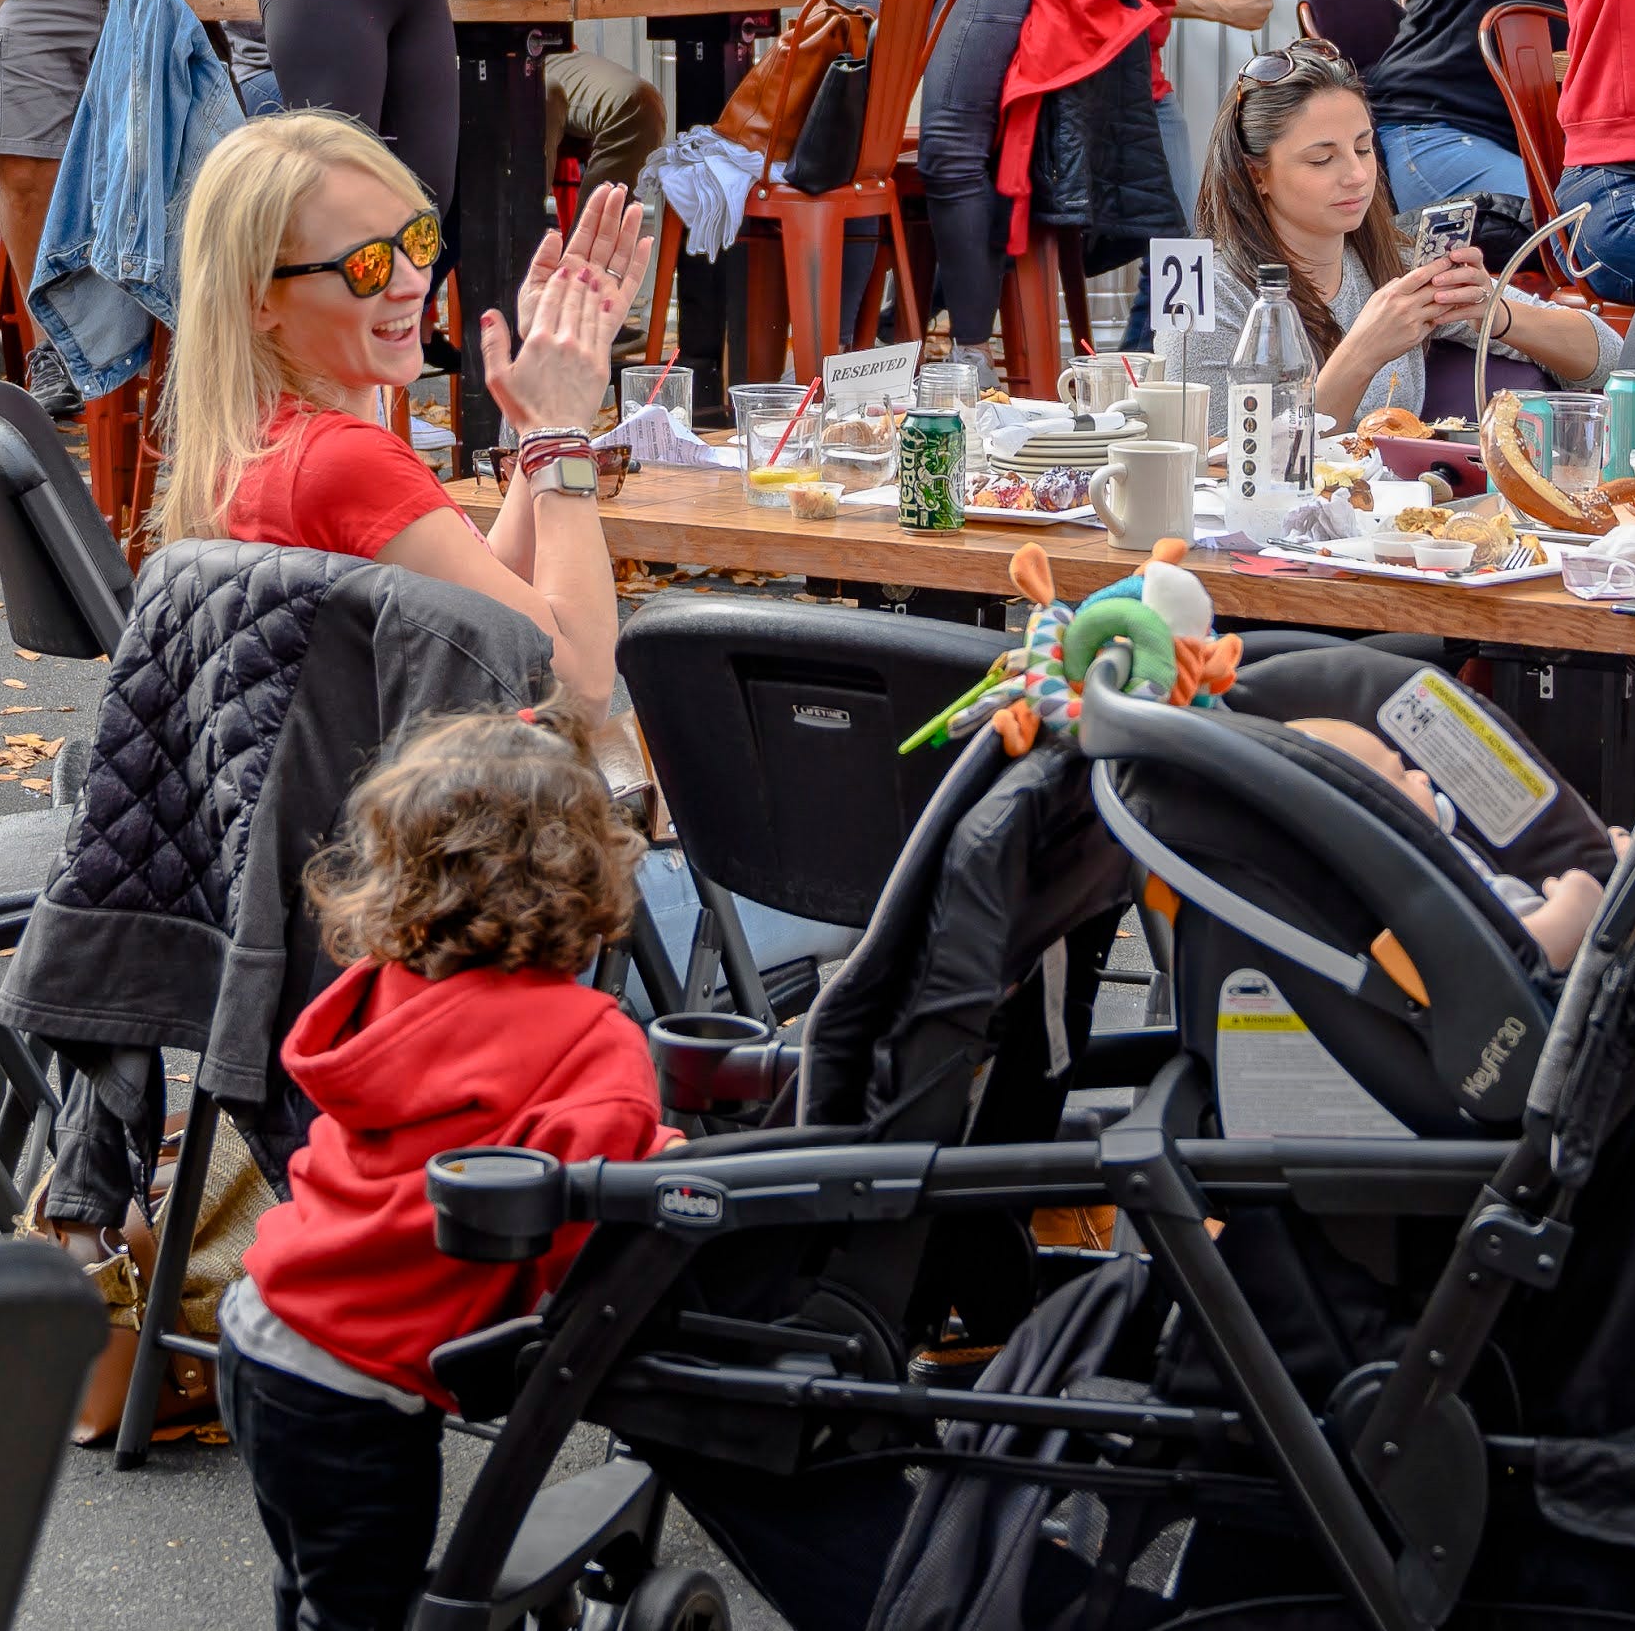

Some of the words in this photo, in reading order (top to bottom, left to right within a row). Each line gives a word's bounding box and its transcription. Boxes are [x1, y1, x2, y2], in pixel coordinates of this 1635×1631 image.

[1161, 254, 1206, 316] 21
[831, 356, 907, 383] RESERVED
[1497, 1016, 1527, 1046] 30
